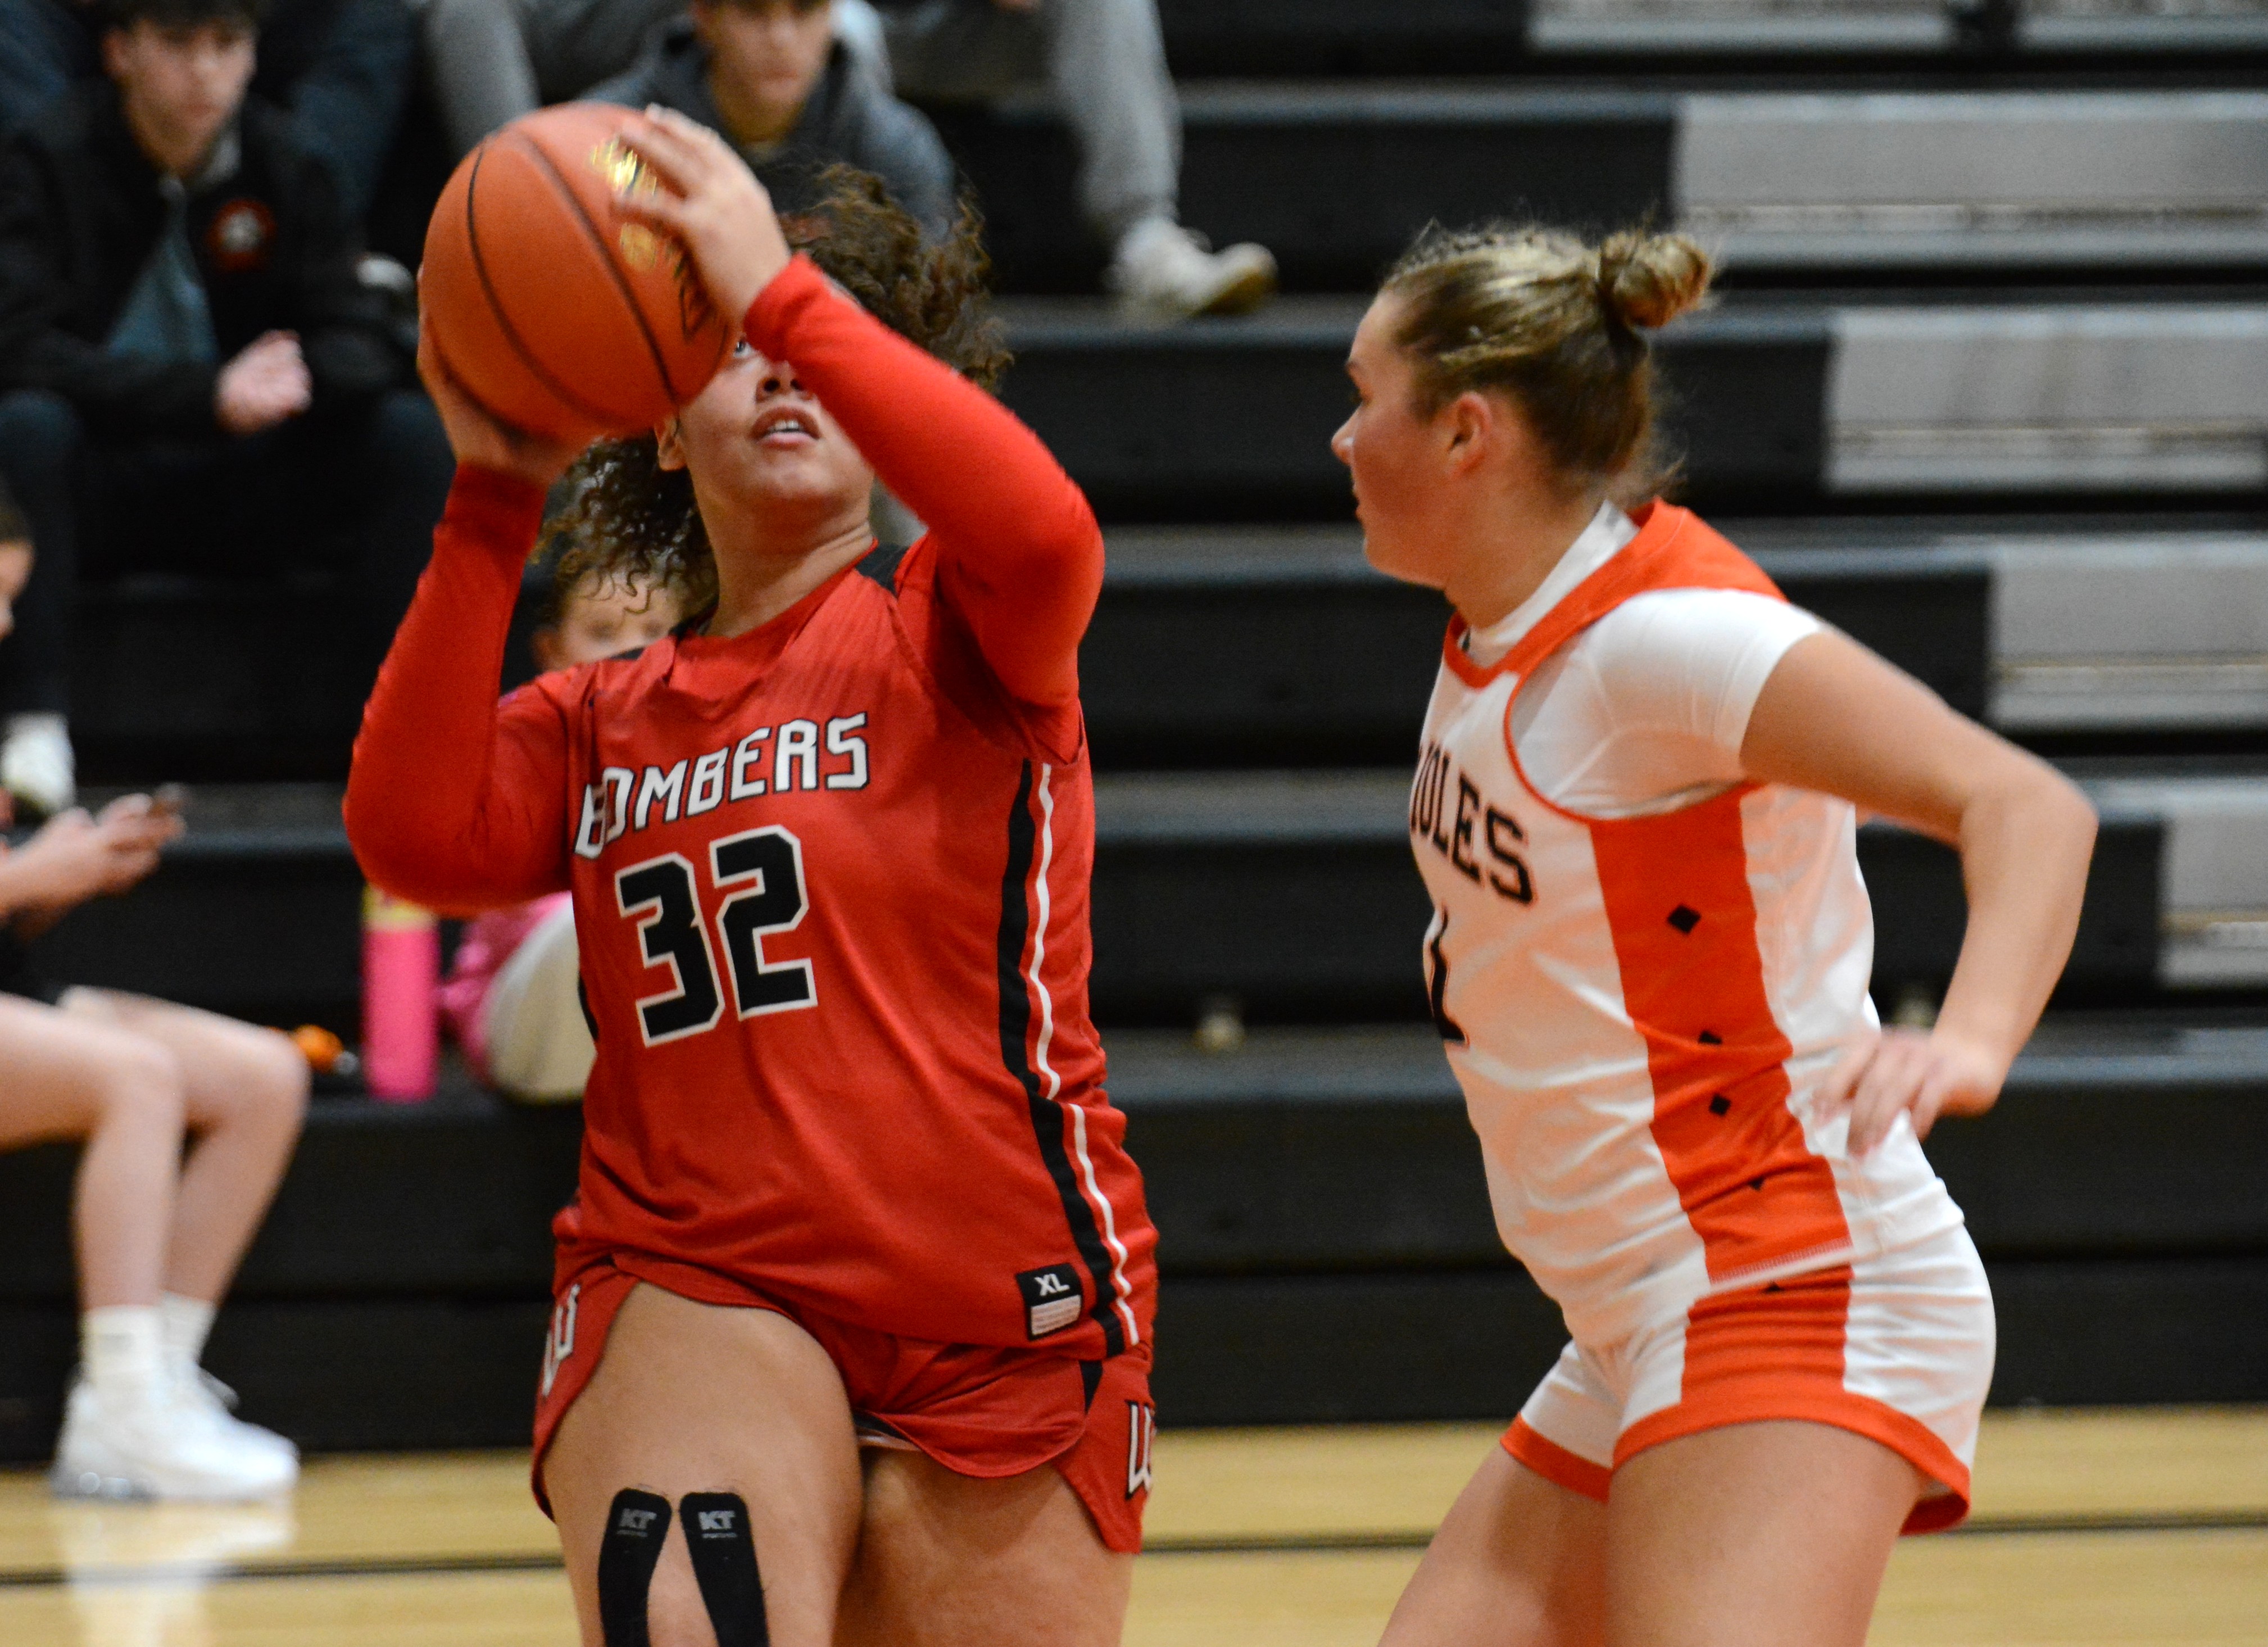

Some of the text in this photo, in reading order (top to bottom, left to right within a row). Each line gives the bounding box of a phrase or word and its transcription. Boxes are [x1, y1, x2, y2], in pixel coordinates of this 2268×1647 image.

[574, 711, 869, 859] BOMBERS
[1409, 741, 1539, 909] IOLES
[615, 824, 818, 1049] 32
[1033, 1272, 1071, 1297] XL
[618, 1508, 657, 1530] KT
[698, 1510, 736, 1530] KT
